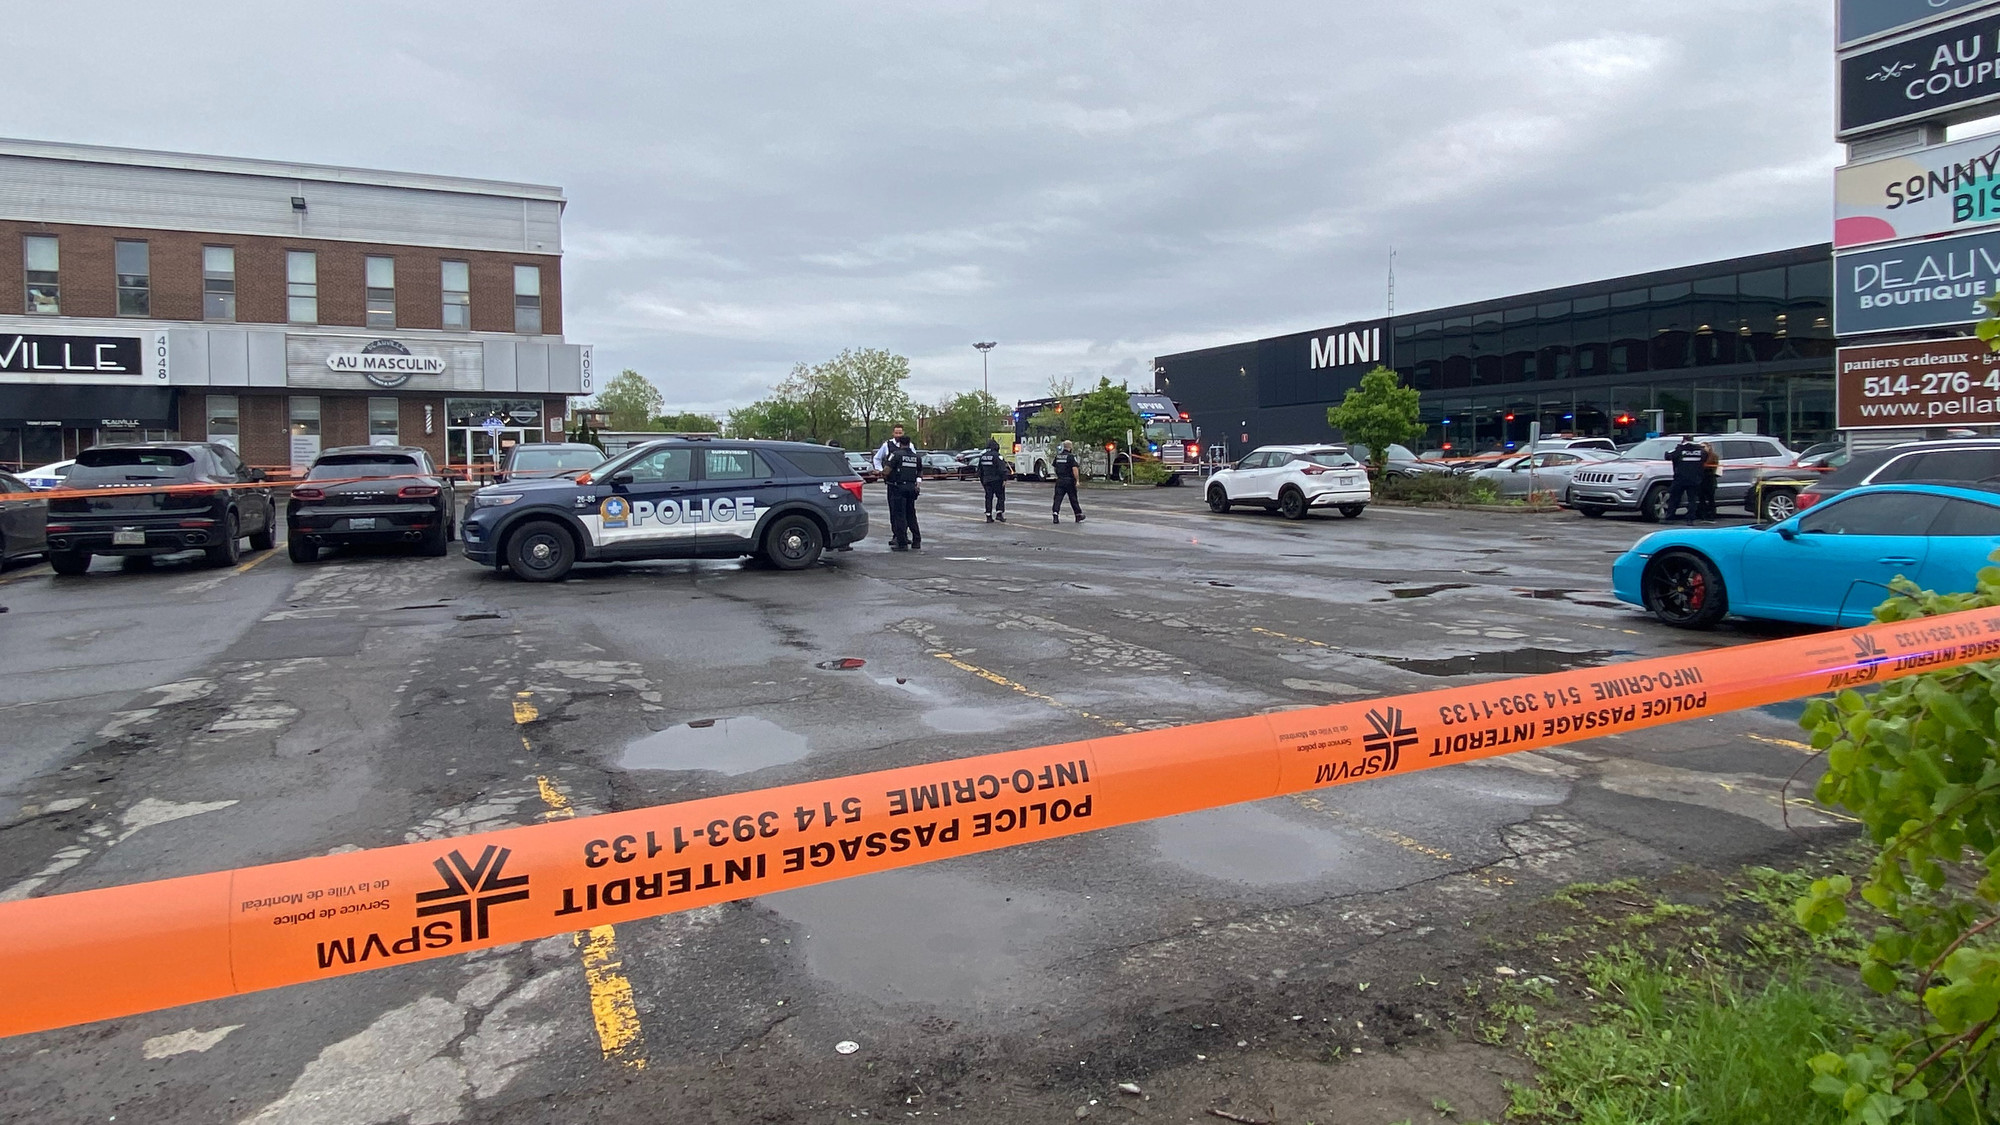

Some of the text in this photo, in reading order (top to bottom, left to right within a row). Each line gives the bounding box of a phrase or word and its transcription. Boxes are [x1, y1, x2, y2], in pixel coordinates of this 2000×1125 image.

[1929, 34, 1981, 72] AU
[1860, 280, 1987, 309] BOUTIQUE
[157, 335, 167, 379] 4048
[336, 356, 437, 371] AU MASCULIN
[1310, 327, 1380, 370] MINI
[1843, 357, 1900, 374] paniers
[1902, 353, 1969, 367] cadeaux
[583, 350, 591, 389] 4050
[1863, 369, 2000, 398] 514-276-4
[1136, 402, 1165, 410] SPVM
[1860, 396, 2000, 419] www.pellat
[632, 496, 757, 527] POLICE
[1439, 666, 1704, 726] INFO-CRIME 514 393-1133
[1429, 691, 1708, 757] POLICE PASSAGE INTERDIT
[1297, 737, 1352, 753] Service de police
[1314, 755, 1383, 784] SPVM
[583, 759, 1091, 869] INFO-CRIME 514 393-1133
[553, 794, 1093, 916] POLICE PASSAGE INTERDIT
[241, 878, 390, 913] de la Ville de Montréal
[273, 899, 391, 928] Service de police
[316, 920, 453, 969] SPVM
